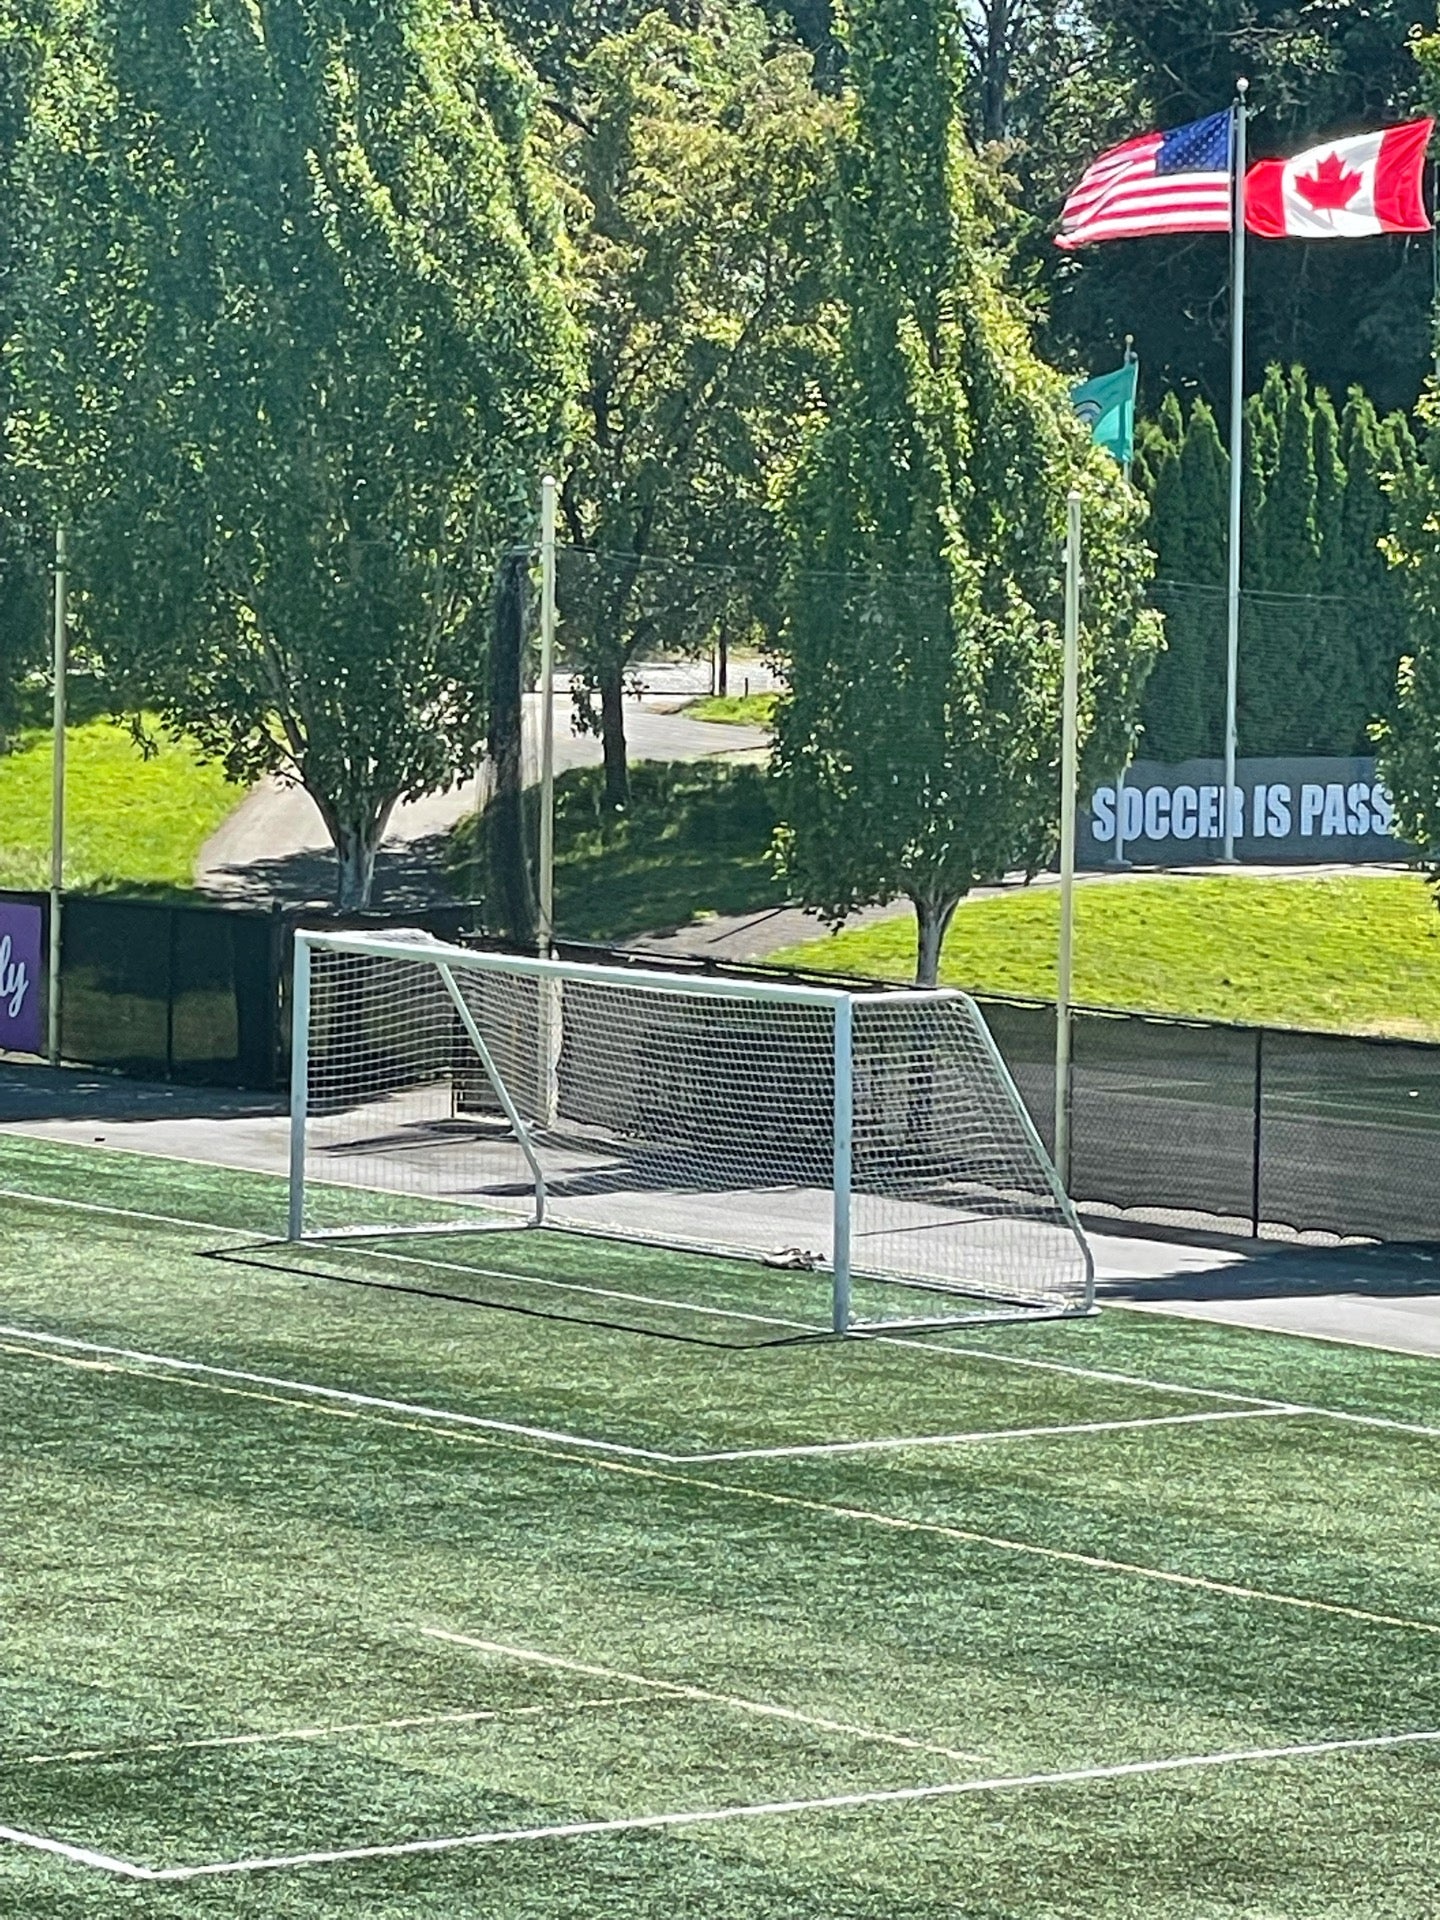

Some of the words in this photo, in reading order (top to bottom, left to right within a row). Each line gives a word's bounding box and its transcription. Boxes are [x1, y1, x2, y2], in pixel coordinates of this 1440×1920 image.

[1092, 785, 1245, 842] SOCCER
[1253, 784, 1292, 838] IS
[1301, 783, 1395, 836] PASS
